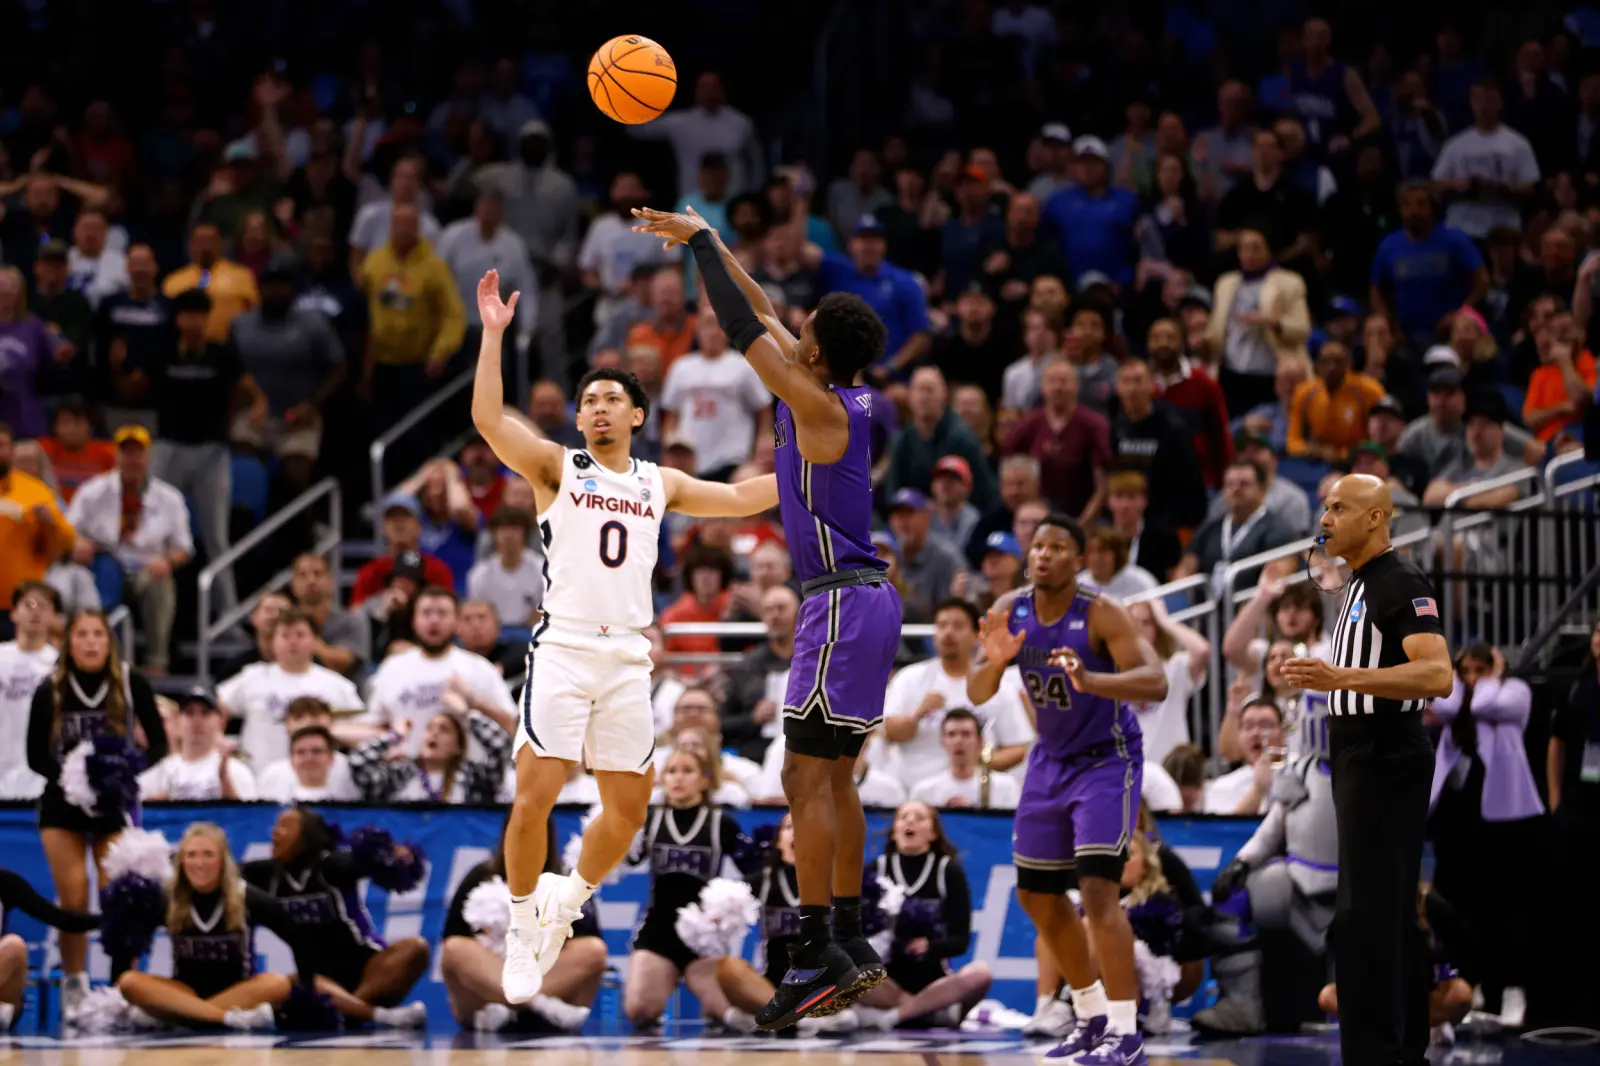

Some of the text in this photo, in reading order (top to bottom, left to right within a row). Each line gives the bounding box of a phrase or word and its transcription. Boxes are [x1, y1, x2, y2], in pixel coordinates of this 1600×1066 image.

[569, 491, 656, 520] VIRGINIA
[599, 520, 629, 569] 0
[1024, 670, 1073, 711] 24
